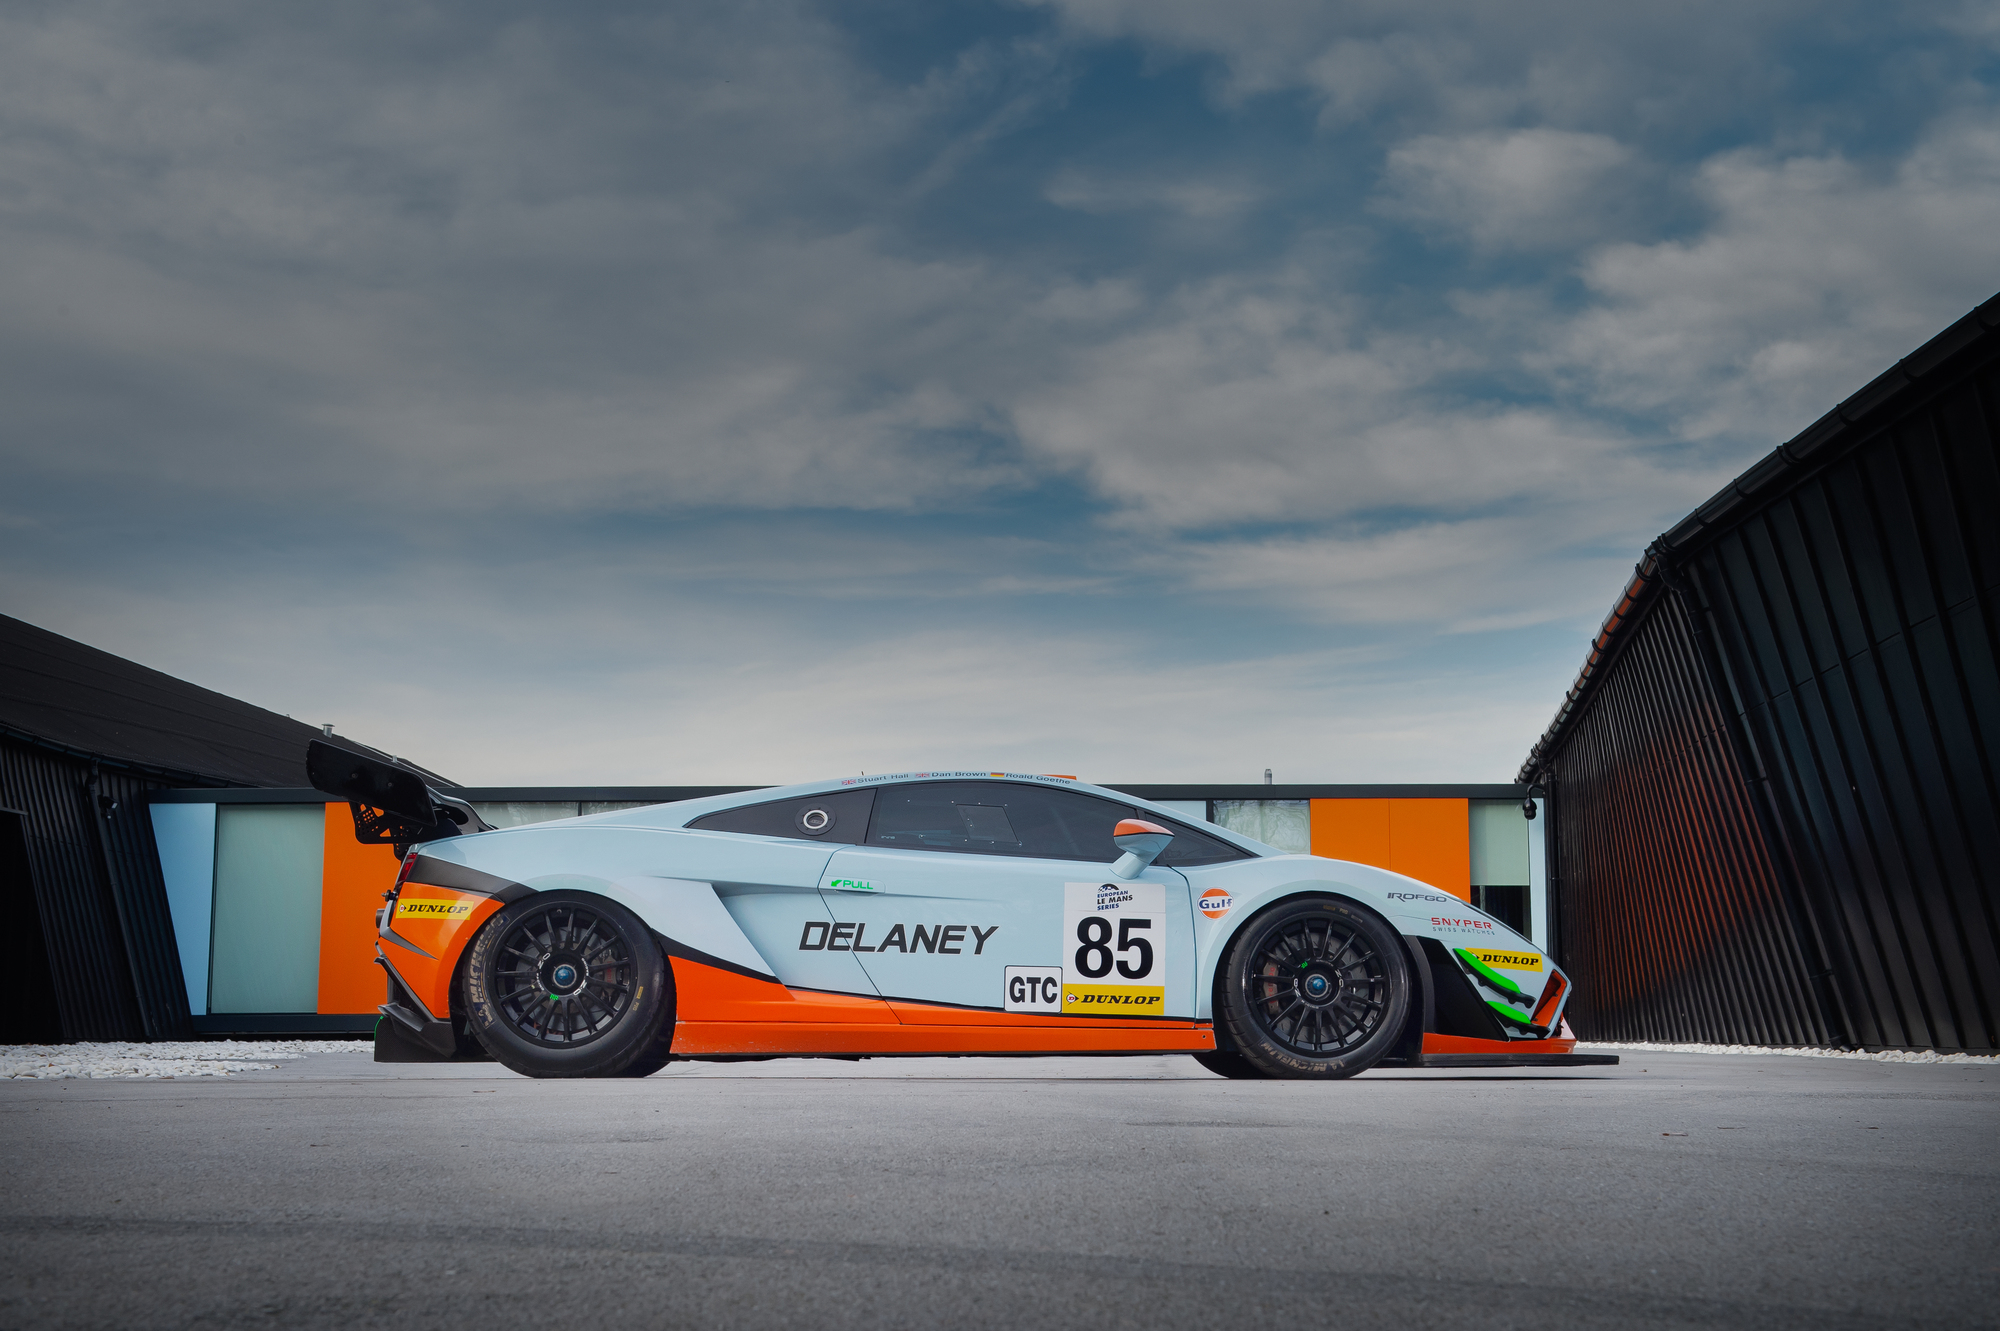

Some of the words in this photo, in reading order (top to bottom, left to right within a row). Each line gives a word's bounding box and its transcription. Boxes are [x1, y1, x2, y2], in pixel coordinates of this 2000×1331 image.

[857, 775, 887, 784] Stuart
[1005, 772, 1033, 780] Roald
[1036, 776, 1071, 785] Goethe
[842, 879, 874, 890] PULL
[1097, 890, 1129, 898] EUROPEAN
[1109, 894, 1133, 903] MANS
[407, 904, 469, 914] DUNLOP
[1097, 903, 1120, 911] SERIES
[1198, 898, 1233, 909] Gulf
[1431, 917, 1493, 930] SNYPER
[1460, 928, 1495, 936] WATCHES
[798, 921, 1000, 955] DELANEY
[1074, 916, 1154, 980] 85
[1481, 953, 1539, 966] DUNLOP
[1009, 975, 1058, 1004] GTC
[1081, 994, 1161, 1005] DUNLOP
